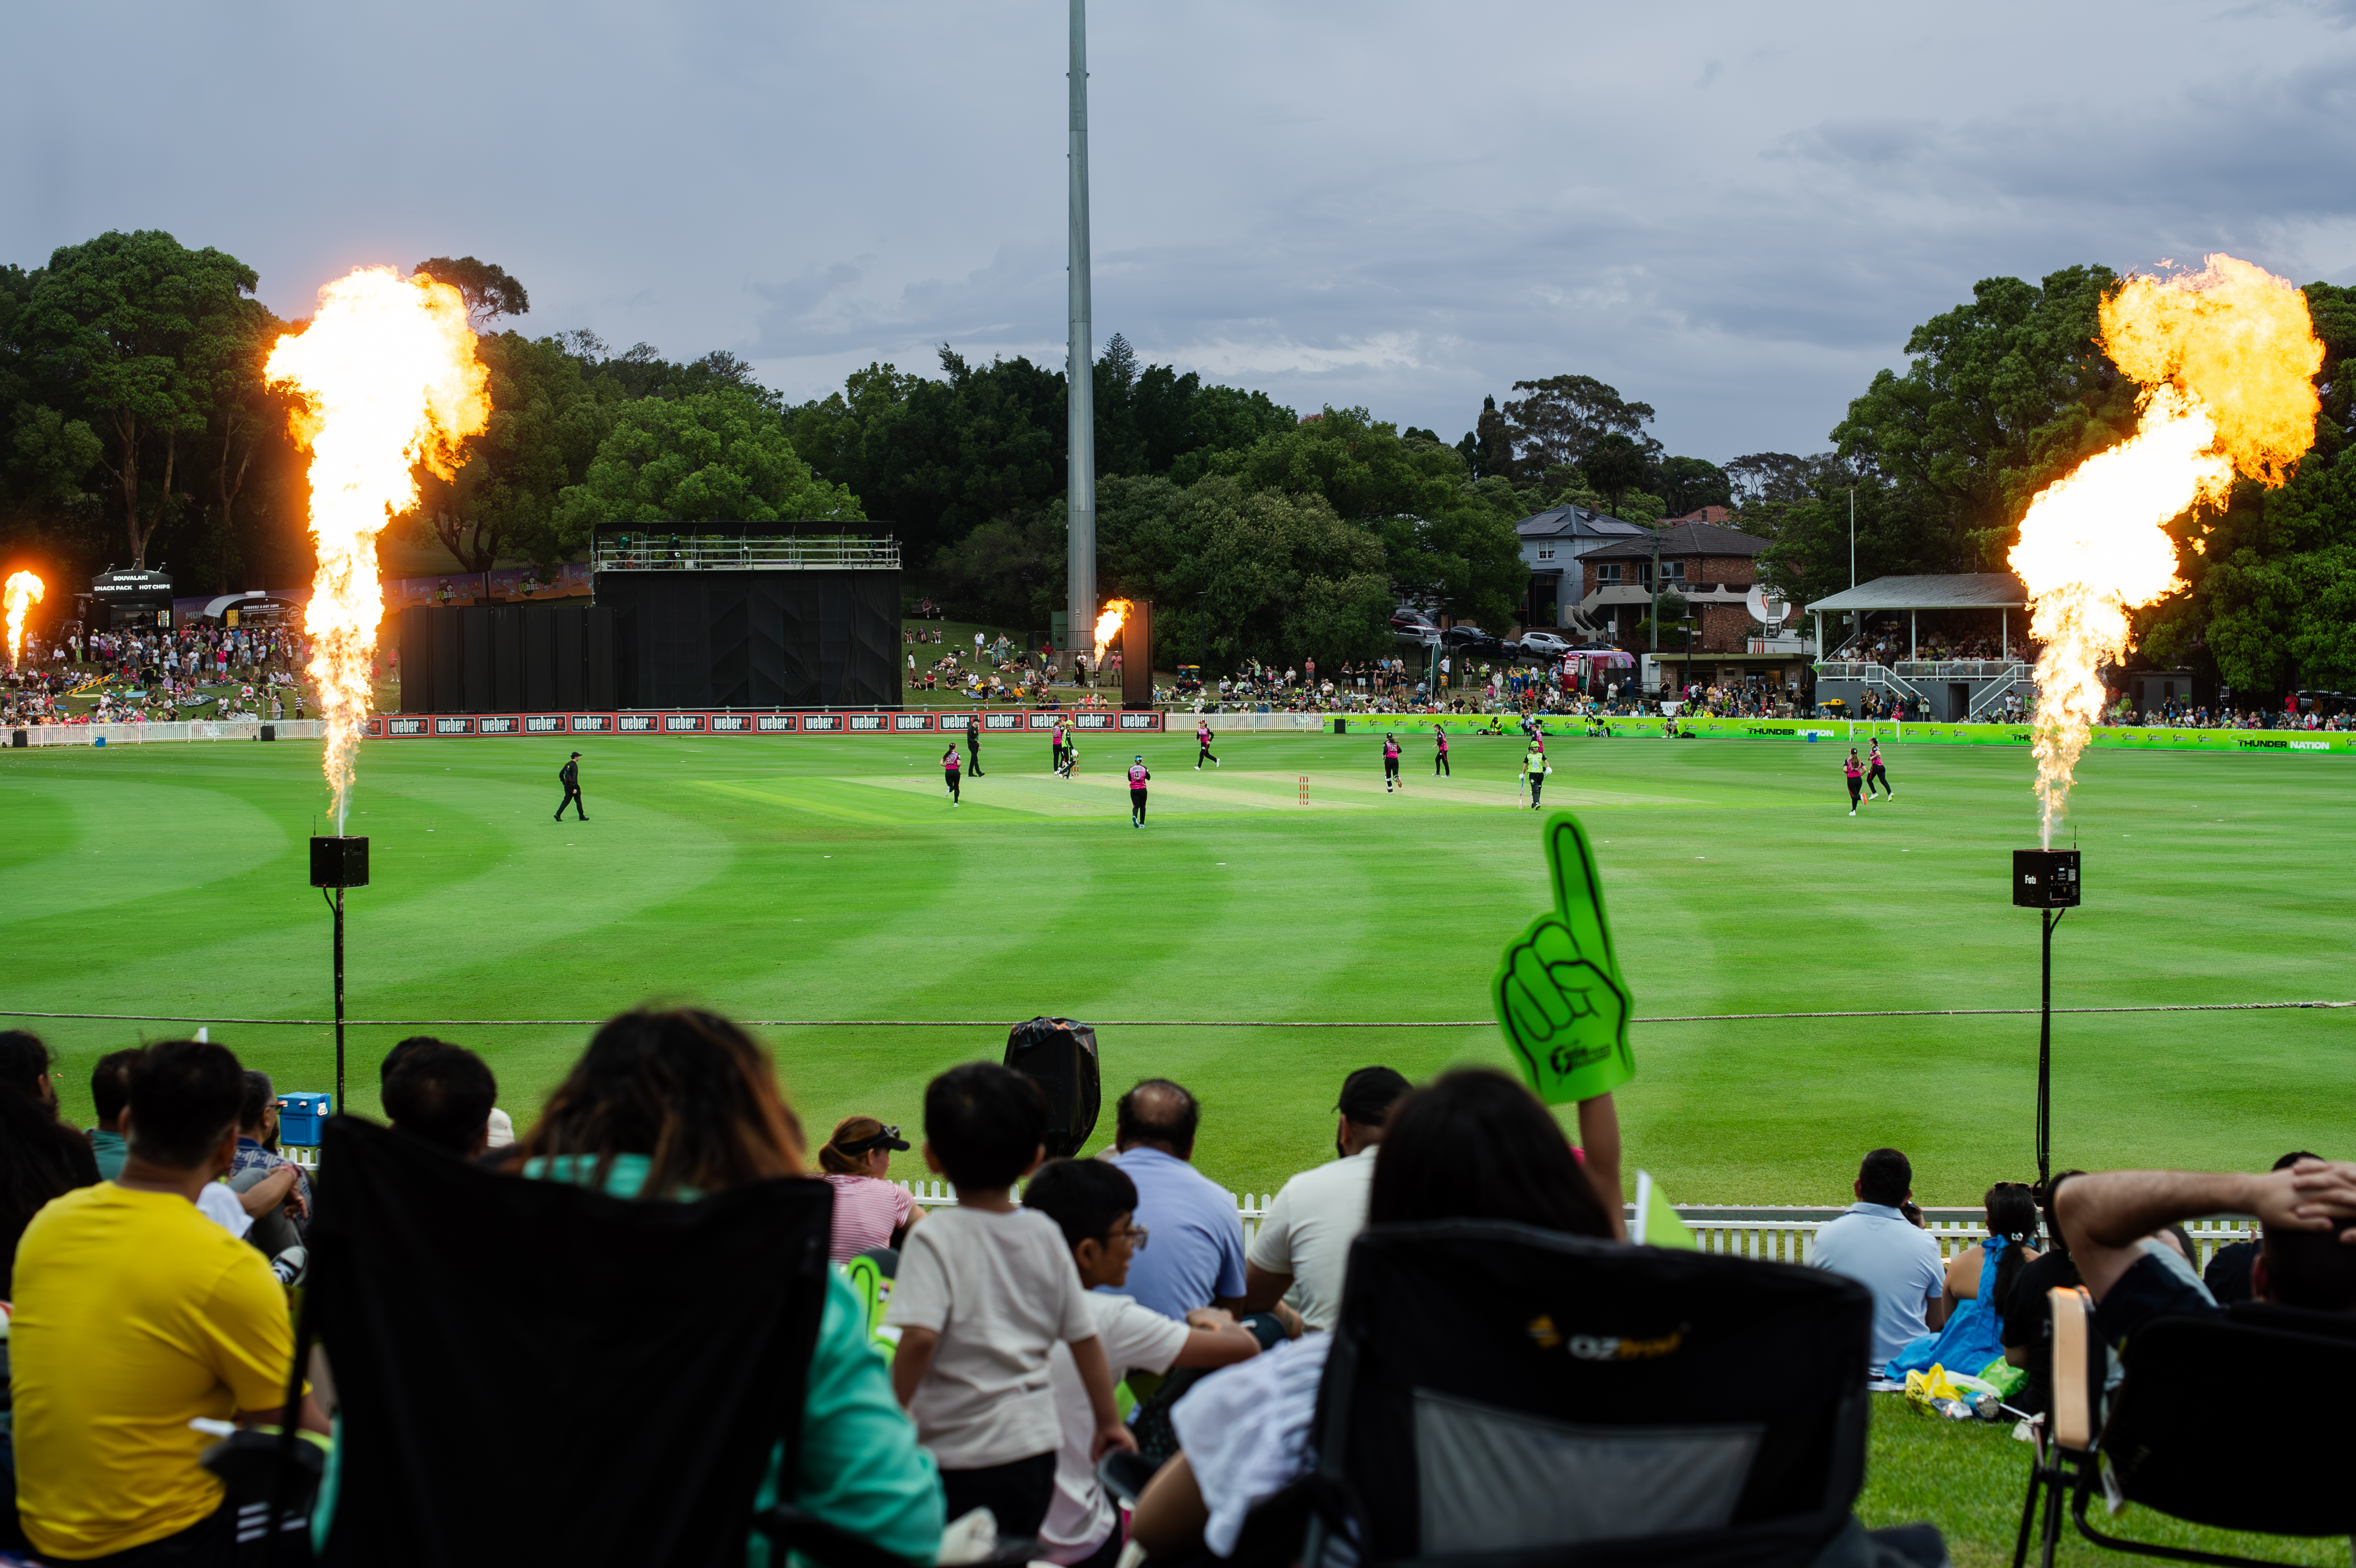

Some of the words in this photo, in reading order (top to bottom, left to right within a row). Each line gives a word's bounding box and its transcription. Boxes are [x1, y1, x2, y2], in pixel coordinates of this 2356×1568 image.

[391, 718, 419, 733] weber
[438, 718, 465, 733] weber
[482, 717, 510, 732] weber
[528, 717, 556, 730] weber
[574, 716, 602, 730] weber
[620, 716, 649, 730] weber
[667, 715, 696, 729] weber
[714, 715, 742, 729] weber
[759, 715, 787, 729] weber
[805, 715, 833, 729] weber
[852, 715, 879, 729] weber
[897, 715, 925, 729] weber
[942, 714, 969, 728] weber
[987, 714, 1014, 728] weber
[1078, 714, 1105, 727] weber
[1122, 714, 1150, 727] weber
[1797, 729, 1834, 737] NATION
[2290, 741, 2329, 750] NATION
[1134, 771, 1140, 780] 4
